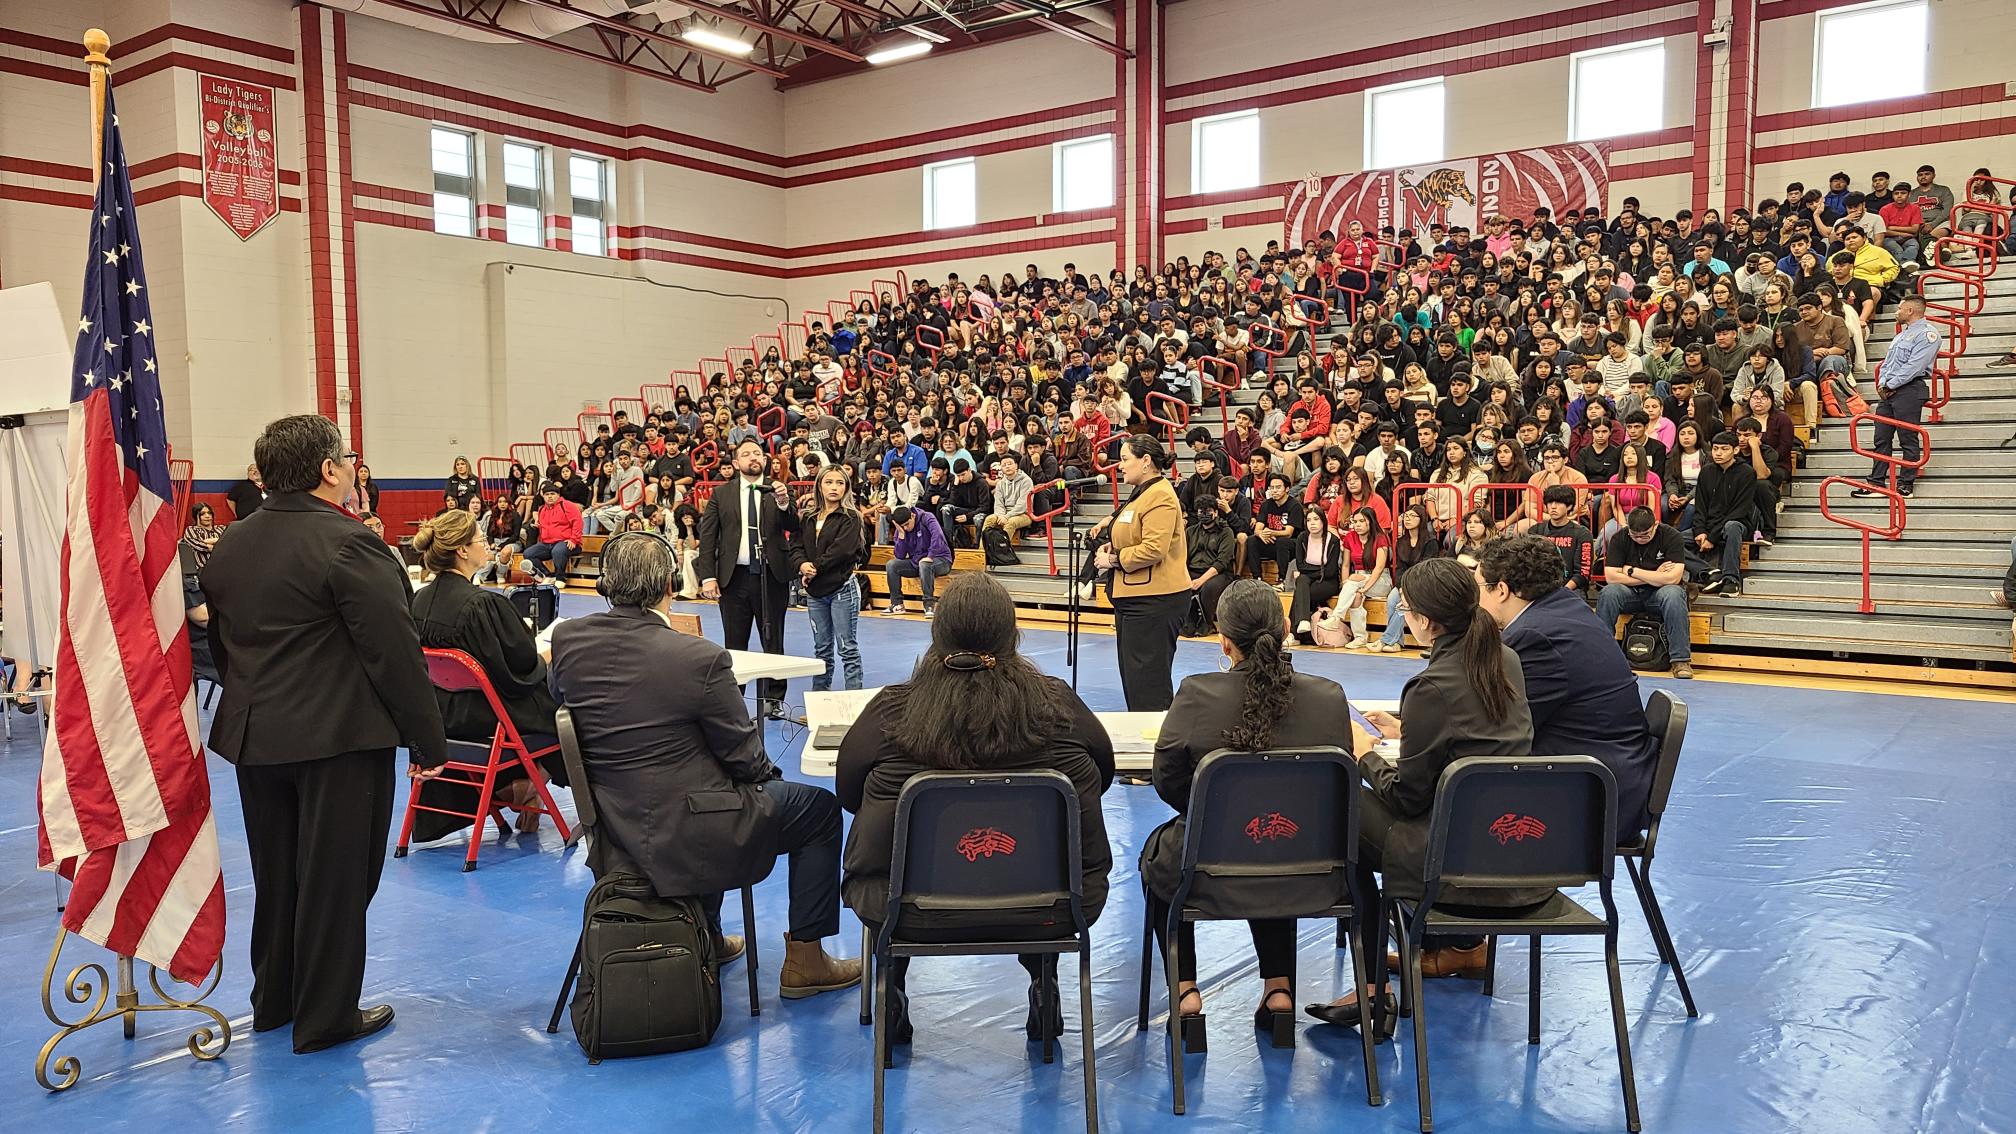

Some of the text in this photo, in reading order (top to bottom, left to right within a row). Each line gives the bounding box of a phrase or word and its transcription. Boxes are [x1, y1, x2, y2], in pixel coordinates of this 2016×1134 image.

[212, 81, 263, 102] Lady Tigers
[212, 140, 267, 157] Volleyball
[217, 154, 264, 169] 2005-2006
